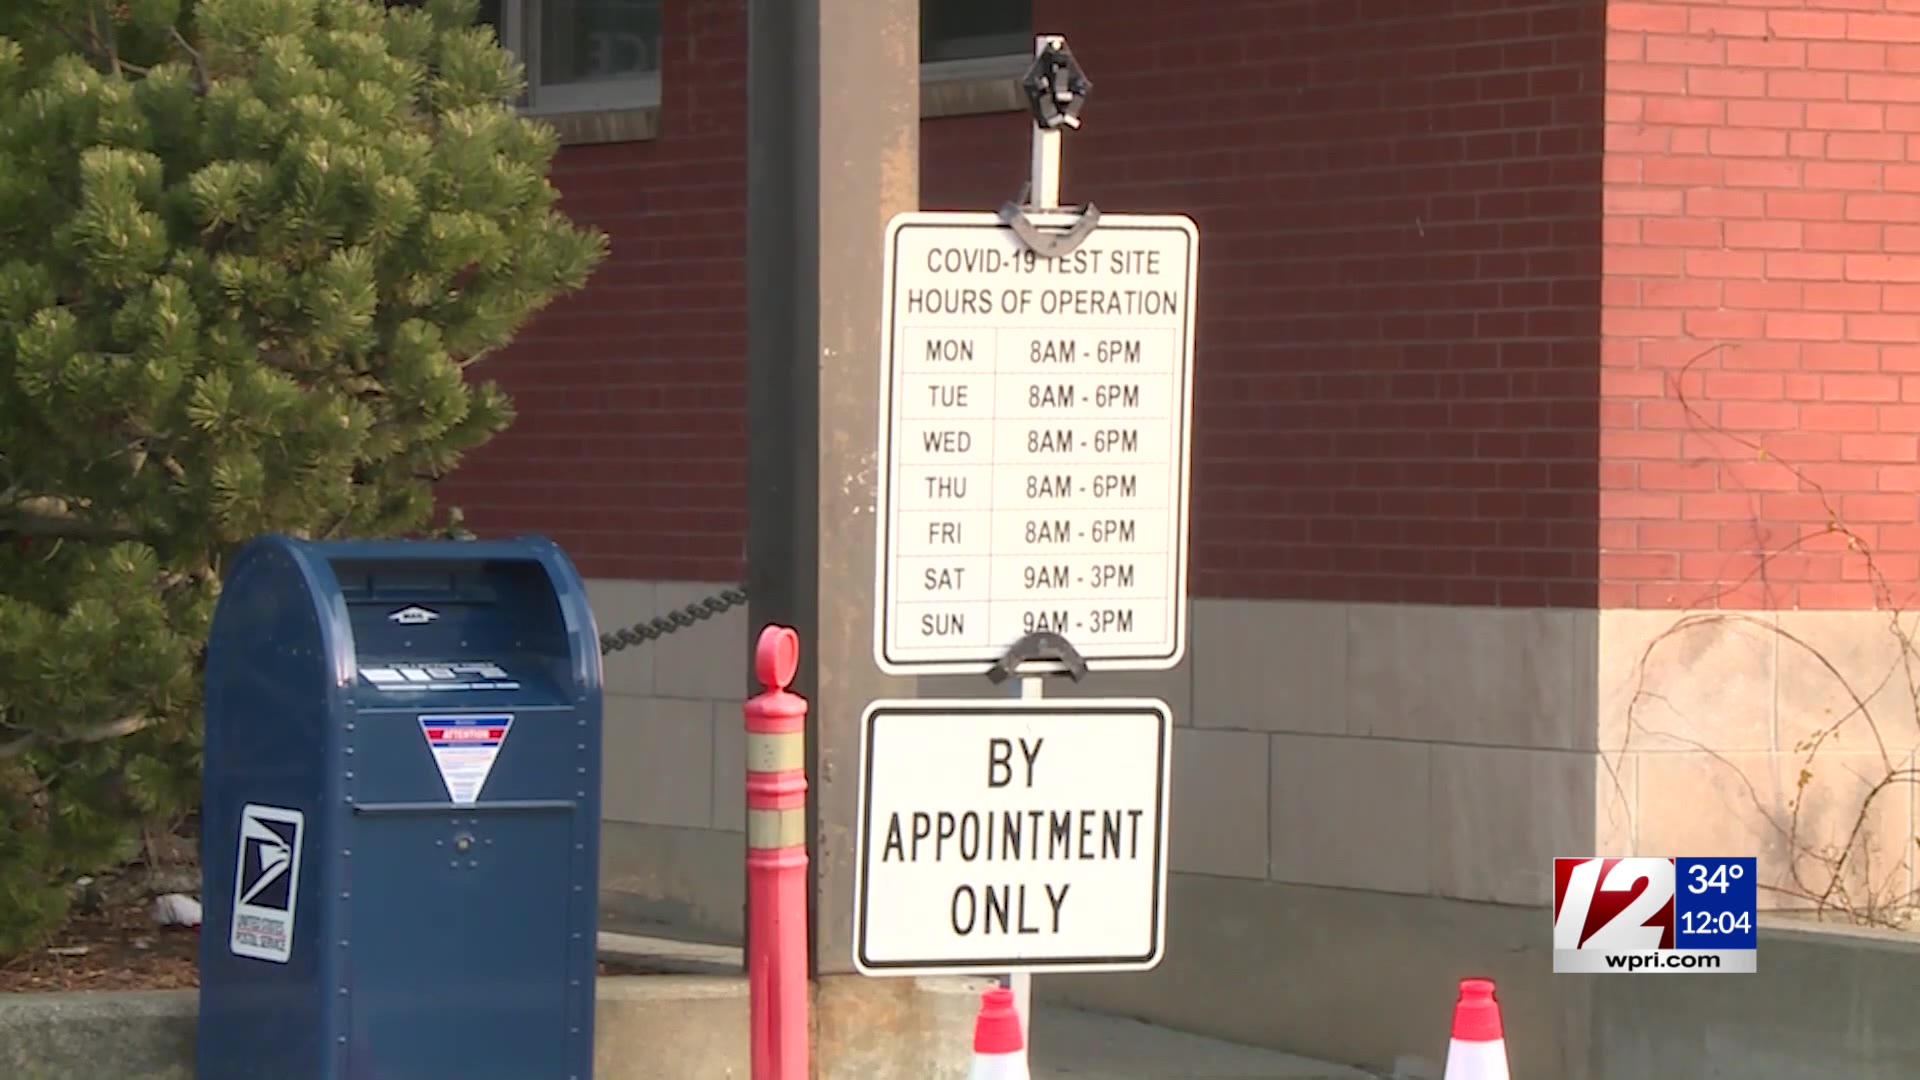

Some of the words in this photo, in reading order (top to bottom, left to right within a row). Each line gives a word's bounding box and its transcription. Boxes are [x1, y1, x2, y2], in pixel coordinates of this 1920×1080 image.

[927, 248, 1035, 274] COVID-19
[1110, 250, 1160, 275] SITE
[908, 288, 993, 314] HOURS
[1001, 289, 1033, 314] OF
[1040, 290, 1178, 315] OPERATION
[925, 340, 974, 361] MON
[1030, 340, 1076, 363] 8AM
[1097, 340, 1141, 363] 6PM
[928, 385, 968, 407] TUE
[1028, 385, 1074, 408] 8AM
[1095, 385, 1139, 408] 6PM
[923, 431, 971, 453] WED
[1027, 431, 1073, 453] 8AM
[1094, 430, 1138, 452] 6PM
[925, 477, 967, 498] THU
[1026, 475, 1072, 498] 8AM
[1093, 475, 1137, 497] 6PM
[928, 522, 961, 544] FRI
[1025, 520, 1070, 543] 8AM
[1091, 520, 1135, 543] 6PM
[924, 568, 965, 590] SAT
[1024, 565, 1069, 589] 9AM
[1090, 564, 1134, 588] 3PM
[921, 614, 964, 636] SUN
[1023, 611, 1068, 634] 9AM
[1089, 610, 1133, 633] 3PM
[988, 738, 1044, 788] BY
[882, 810, 1143, 862] APPOINTMENT
[951, 883, 1071, 936] ONLY
